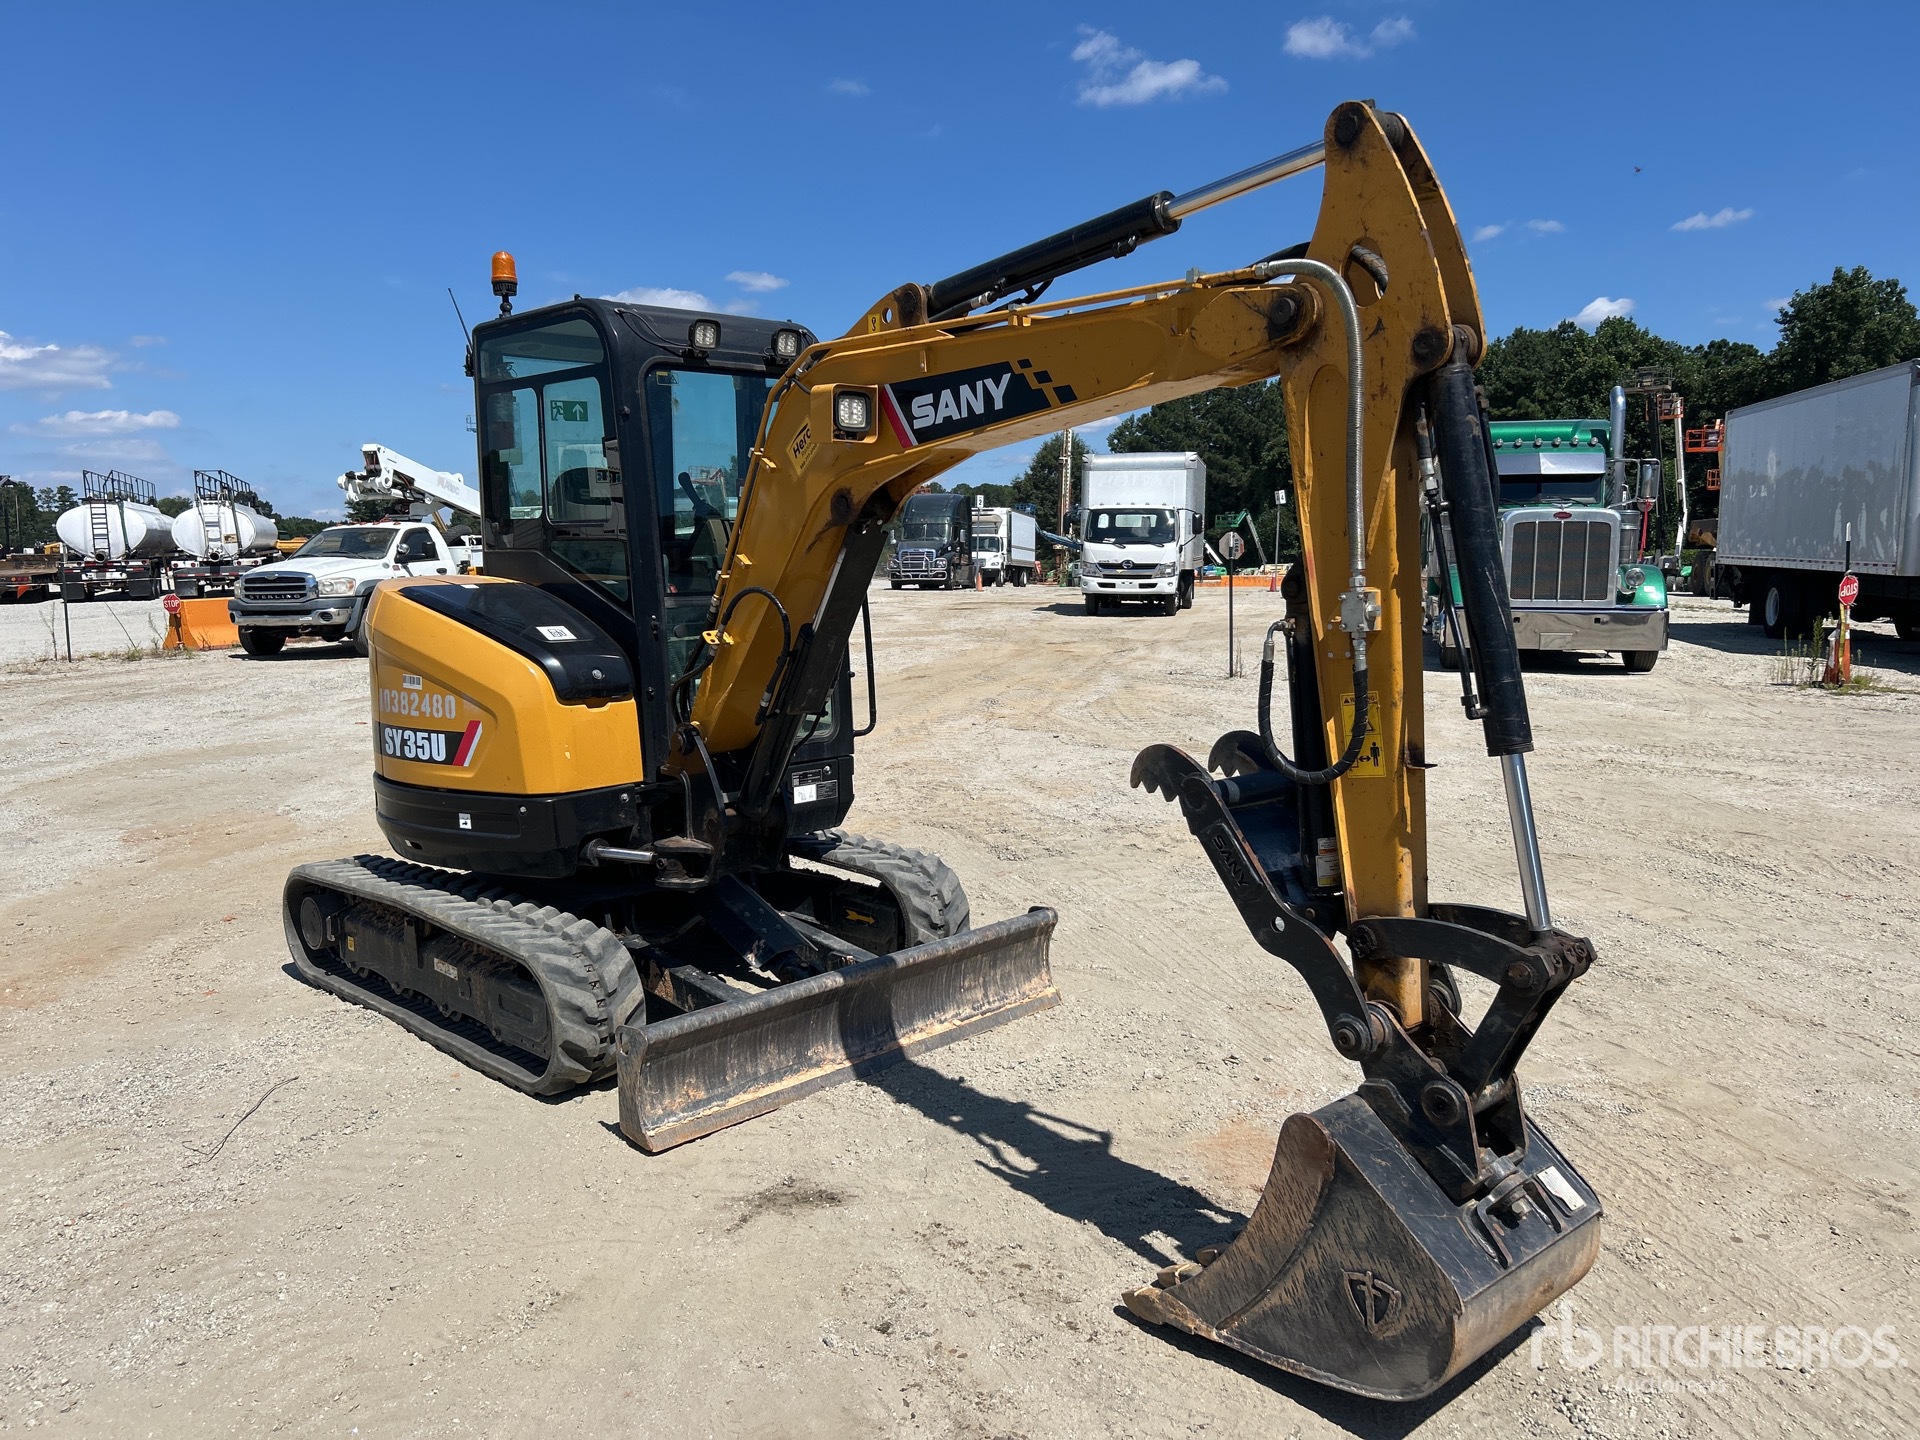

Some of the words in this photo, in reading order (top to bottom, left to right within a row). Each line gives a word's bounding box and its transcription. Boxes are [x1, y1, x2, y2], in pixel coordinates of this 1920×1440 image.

[911, 373, 1012, 430] SANY
[792, 428, 811, 459] Herc
[163, 600, 180, 608] STOP
[1840, 582, 1858, 597] STOP
[384, 727, 447, 762] SY35U
[1212, 834, 1250, 887] SANY
